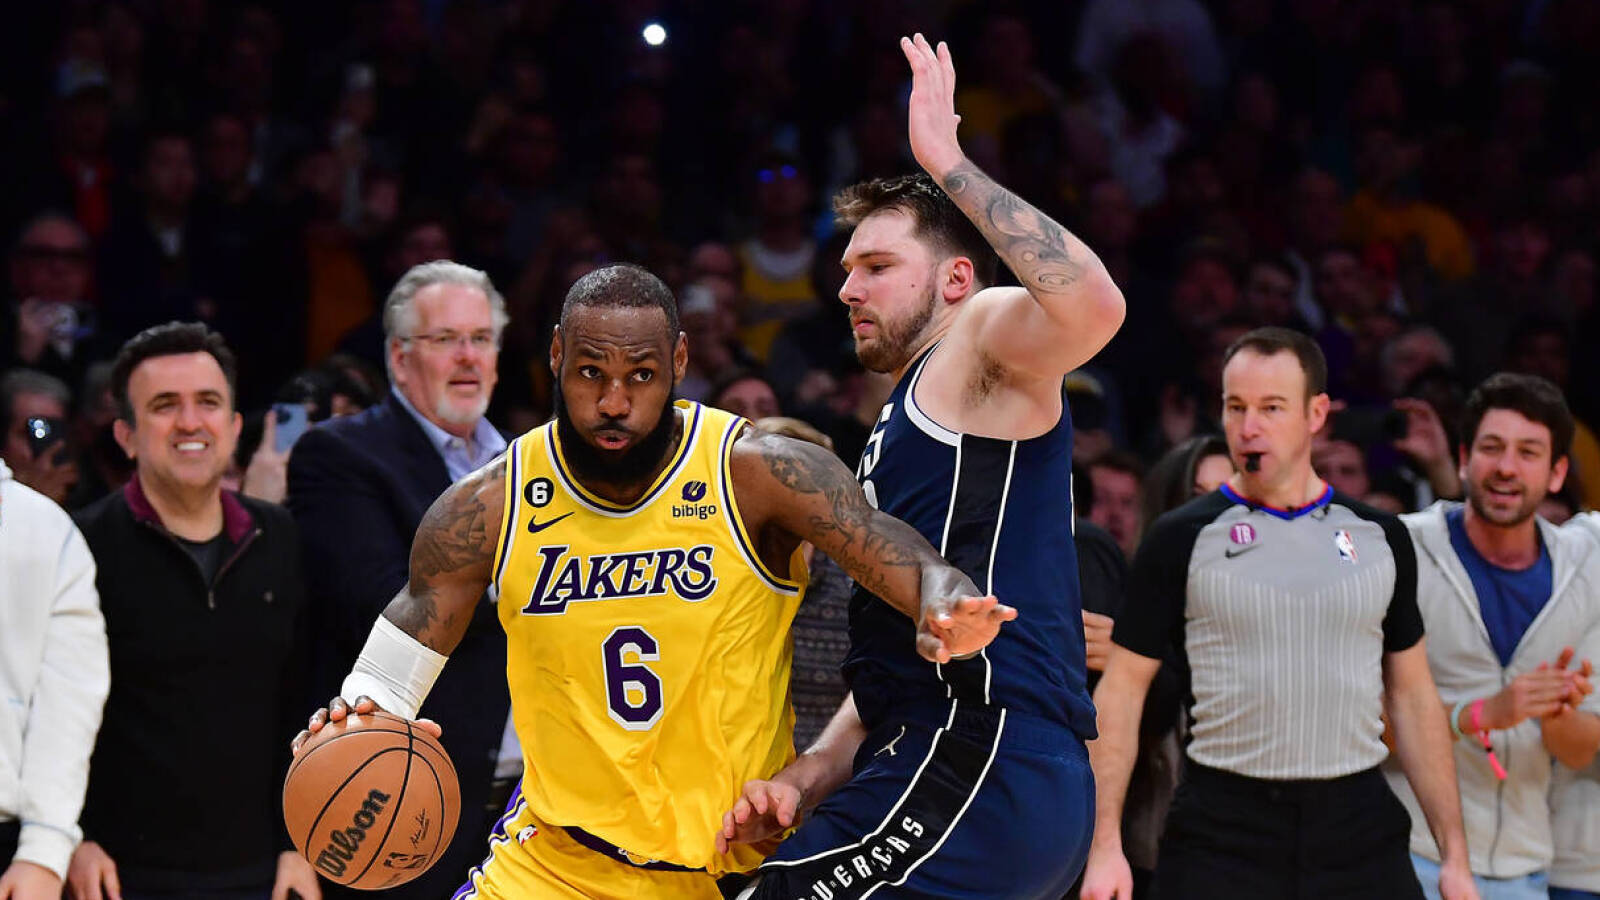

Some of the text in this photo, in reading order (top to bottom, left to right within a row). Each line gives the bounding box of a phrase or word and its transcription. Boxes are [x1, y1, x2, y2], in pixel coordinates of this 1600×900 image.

[532, 481, 548, 504] 6
[672, 504, 717, 520] bibigo
[520, 544, 718, 616] LAKERS
[602, 625, 664, 731] 6
[314, 788, 391, 878] Wilson
